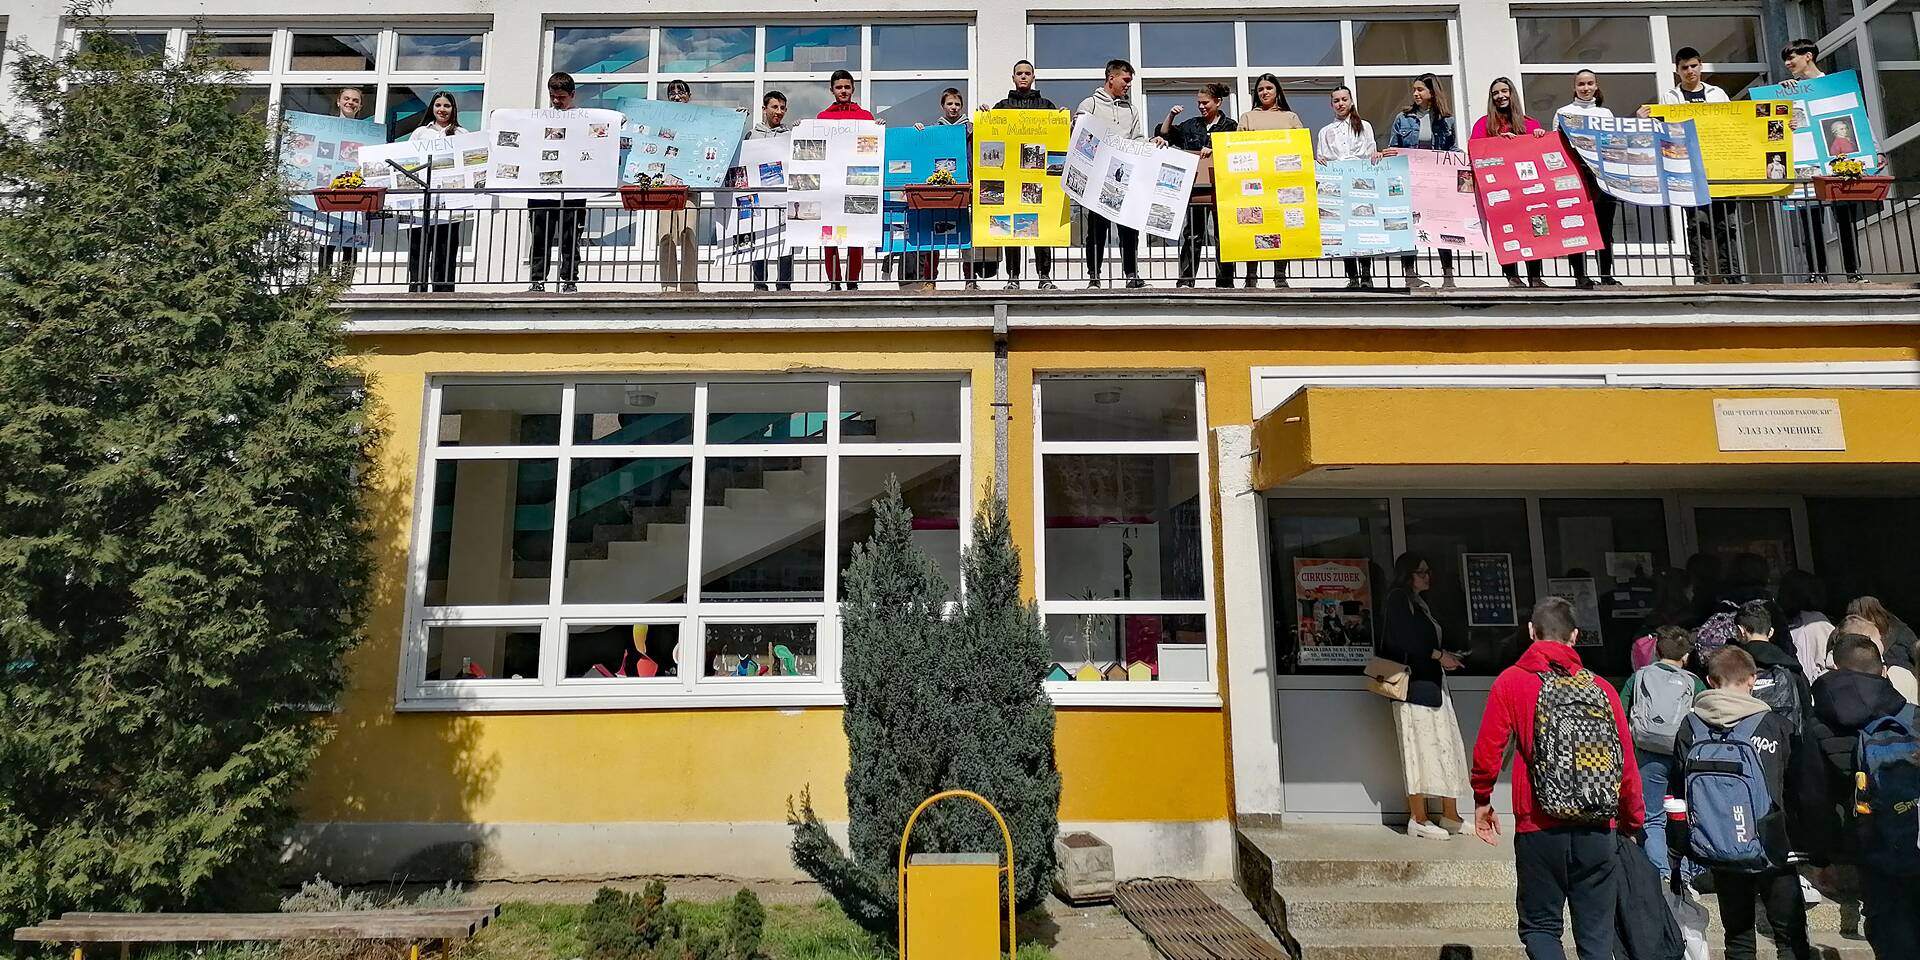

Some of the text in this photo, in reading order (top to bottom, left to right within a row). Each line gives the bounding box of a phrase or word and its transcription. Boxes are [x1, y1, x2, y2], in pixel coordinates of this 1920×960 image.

[1669, 103, 1743, 117] BASKETBALL
[1588, 116, 1666, 134] REISEN
[412, 137, 454, 153] WIEN
[1102, 128, 1154, 158] KARATE
[1737, 426, 1823, 435] УЛАЗ ЗА УЧЕНИКЕ
[1301, 572, 1360, 582] CIRKUS ZUBEK
[1754, 678, 1774, 686] NIKE
[1733, 805, 1748, 843] PULSE
